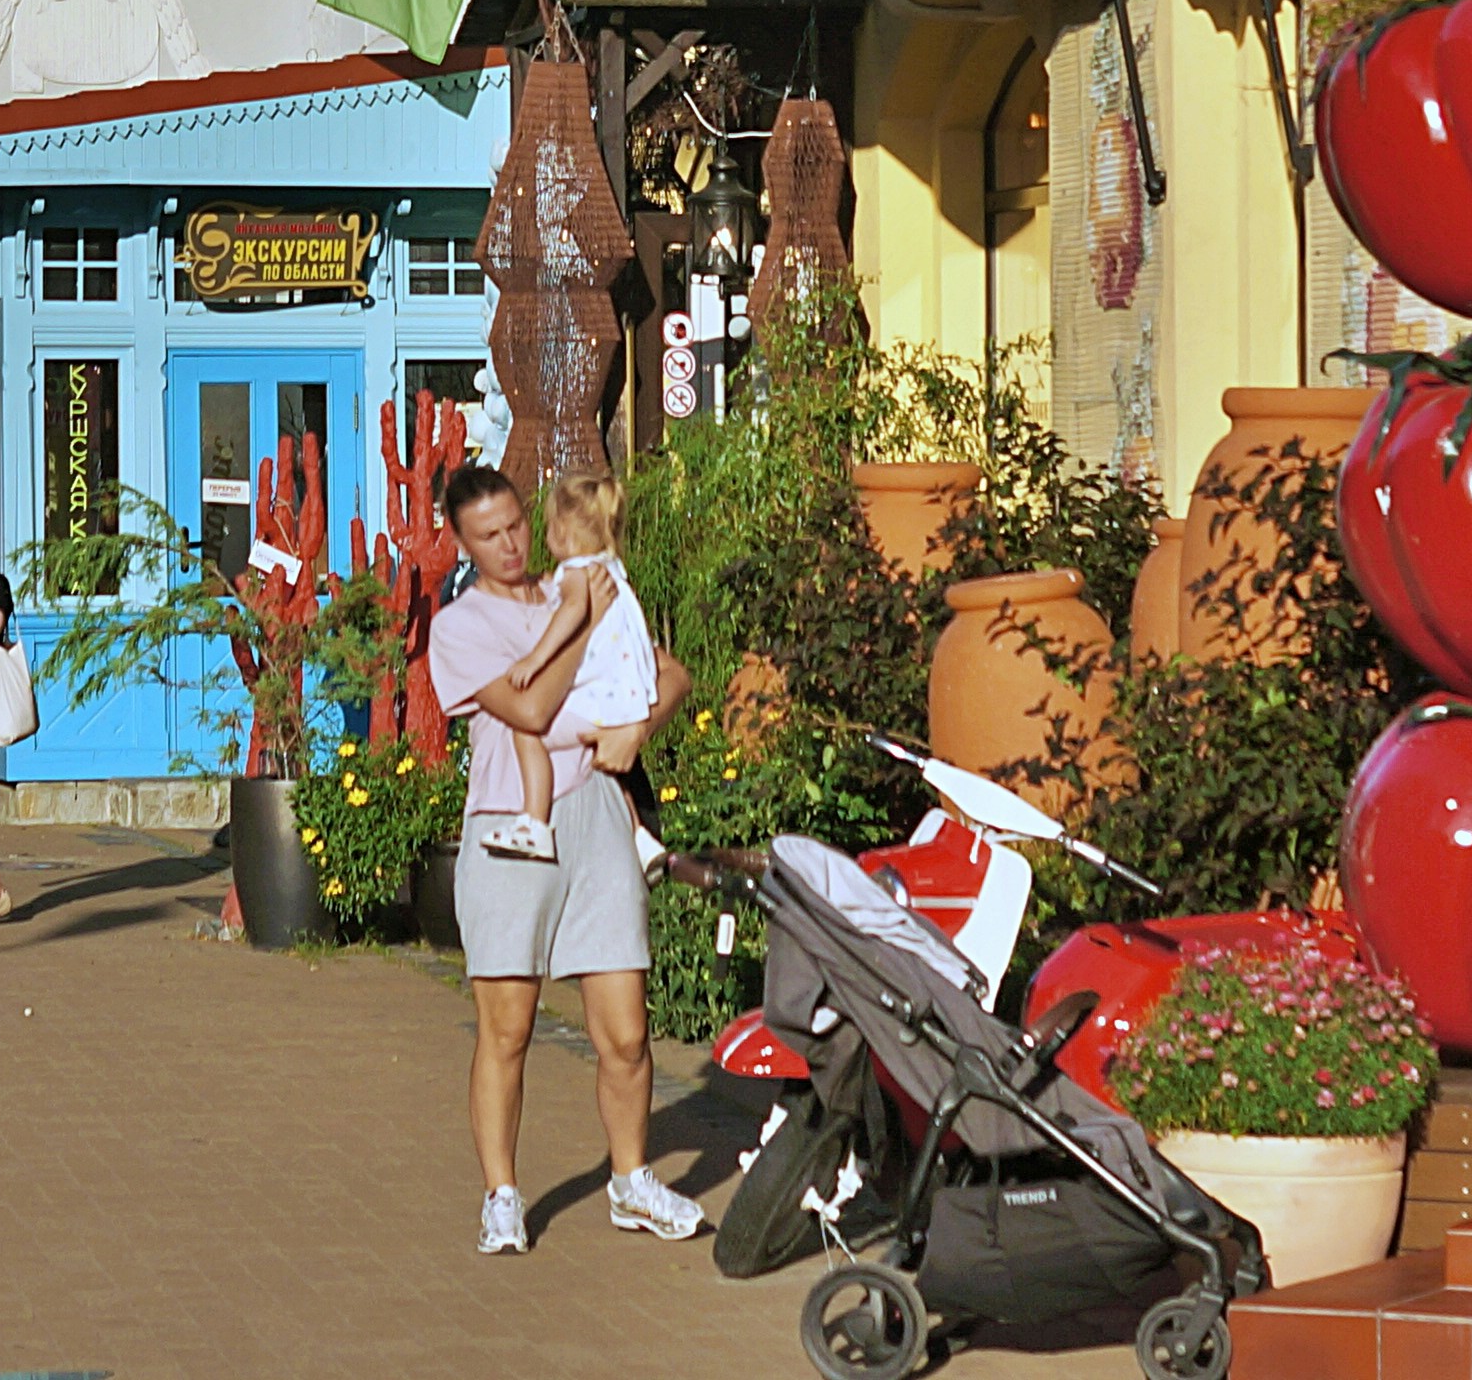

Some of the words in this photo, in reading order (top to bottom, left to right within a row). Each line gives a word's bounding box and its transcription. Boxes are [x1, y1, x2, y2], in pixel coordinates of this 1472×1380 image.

[232, 238, 347, 263] ЭКСКУРСИИ
[262, 264, 279, 281] ПО
[283, 263, 346, 281] ОБЛАСТИ
[69, 363, 88, 512] КУРШСКАЯ
[1003, 1190, 1047, 1207] TREND
